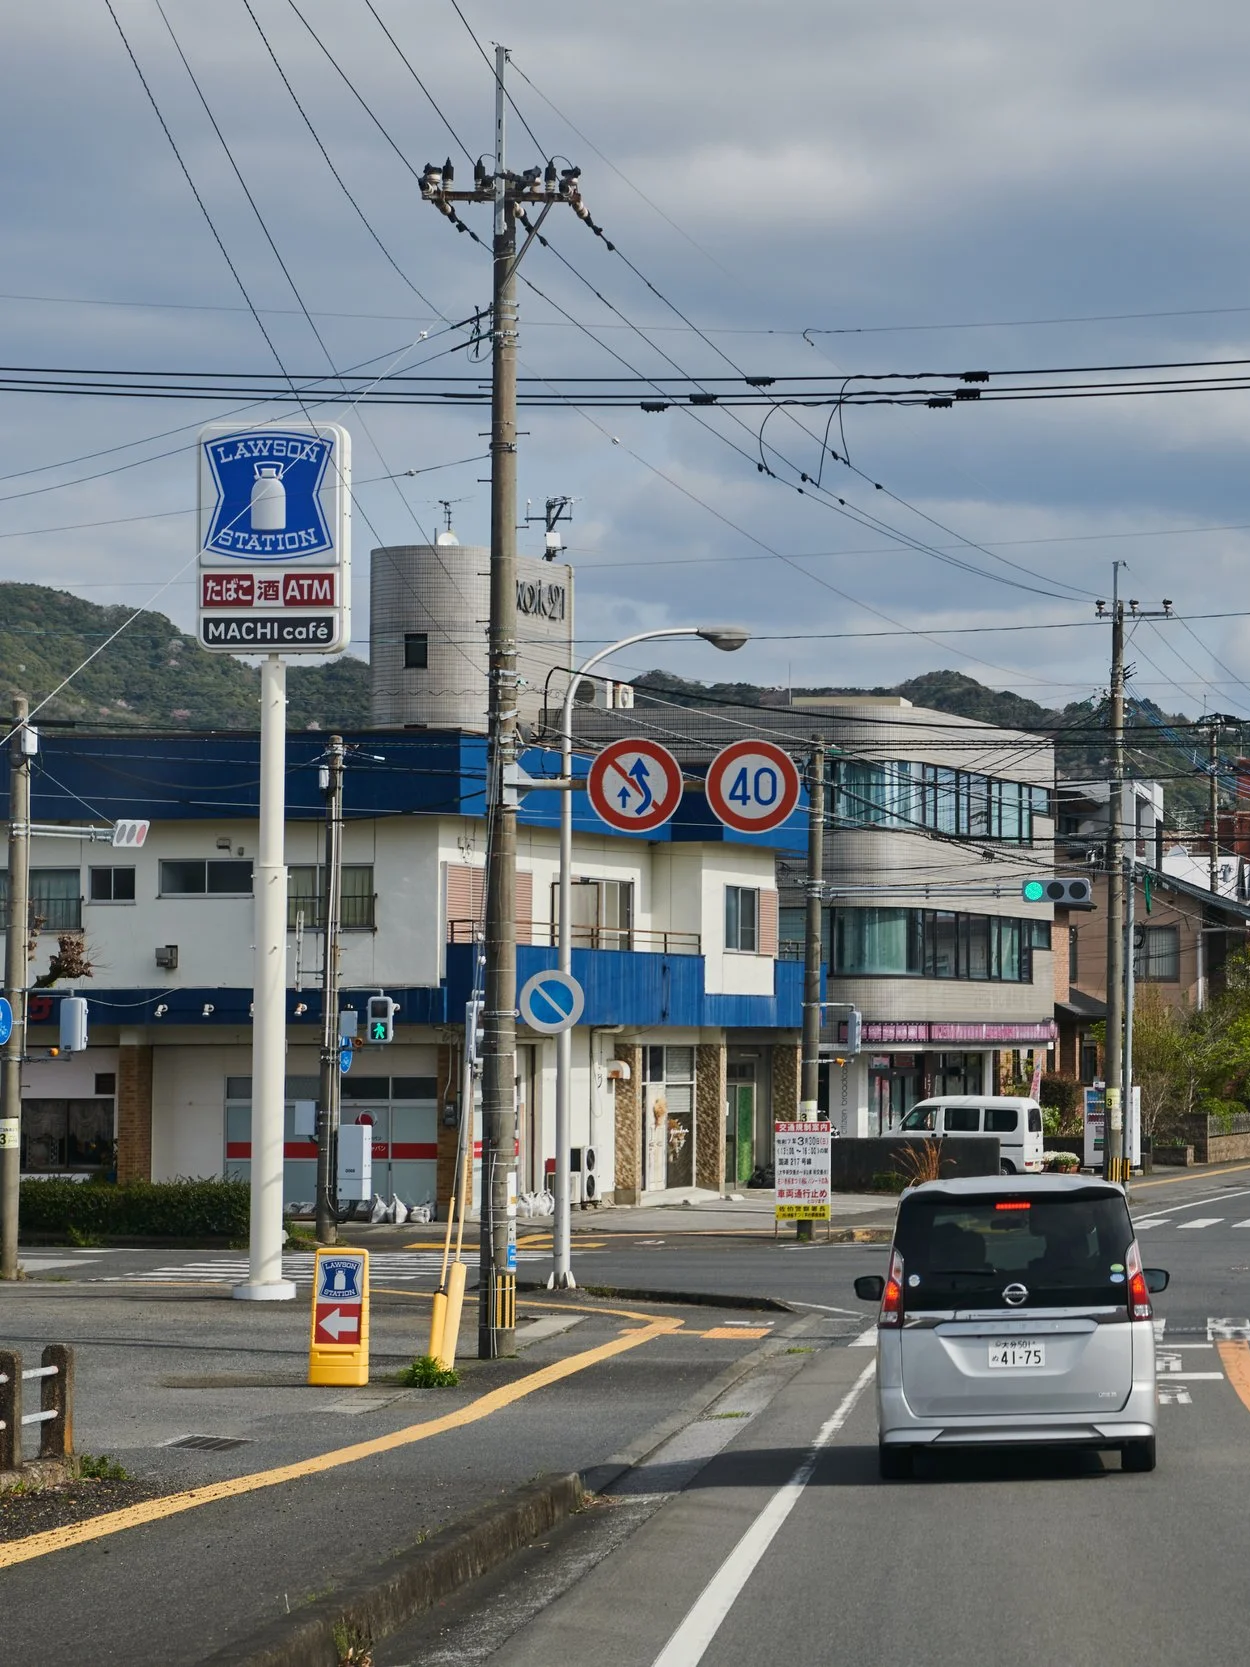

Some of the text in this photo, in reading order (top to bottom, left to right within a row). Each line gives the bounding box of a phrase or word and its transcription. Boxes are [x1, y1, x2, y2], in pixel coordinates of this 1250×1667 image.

[217, 440, 320, 464] LAWSON
[218, 528, 318, 551] STATION
[206, 577, 331, 601] たばこ 酒 ATM
[208, 622, 328, 640] MACHI café
[728, 767, 777, 806] 40
[777, 1189, 828, 1199] 車両通行止め
[325, 1261, 357, 1270] LAWSON
[323, 1288, 356, 1297] STATION
[1001, 1350, 1042, 1365] 41-75
